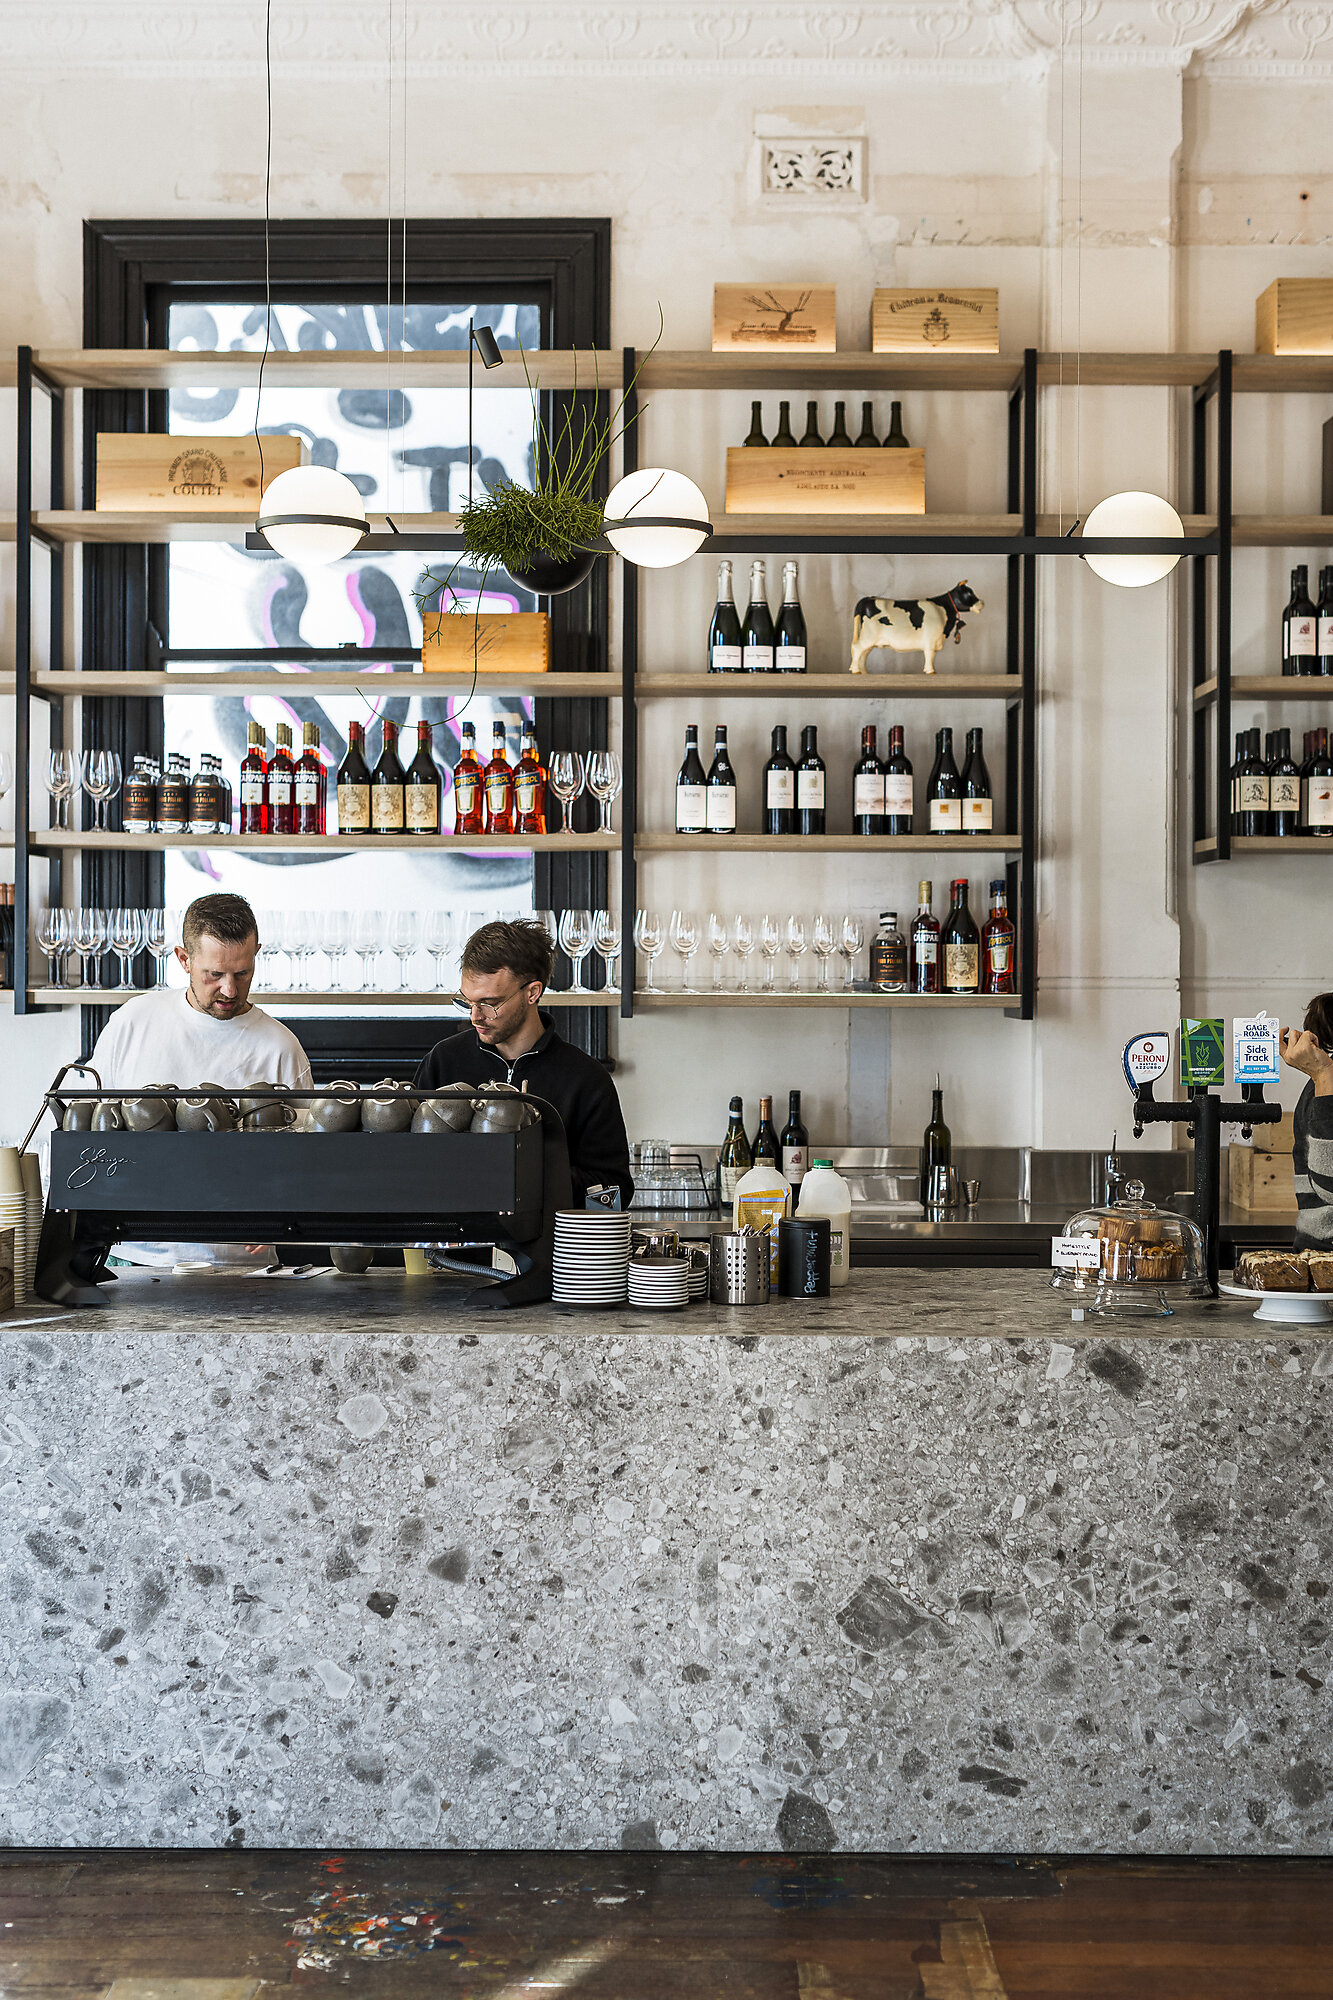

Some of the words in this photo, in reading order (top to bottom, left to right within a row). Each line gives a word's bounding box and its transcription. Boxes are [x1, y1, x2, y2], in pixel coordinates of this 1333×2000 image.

[173, 486, 223, 495] COUTET
[455, 776, 477, 787] APEROL
[486, 776, 509, 787] APEROL
[515, 776, 537, 787] APEROL
[988, 935, 1012, 947] APEROL
[1246, 1045, 1267, 1054] Side
[1131, 1053, 1165, 1063] PERONI
[1244, 1053, 1269, 1062] Track
[803, 1229, 820, 1294] Peppermint
